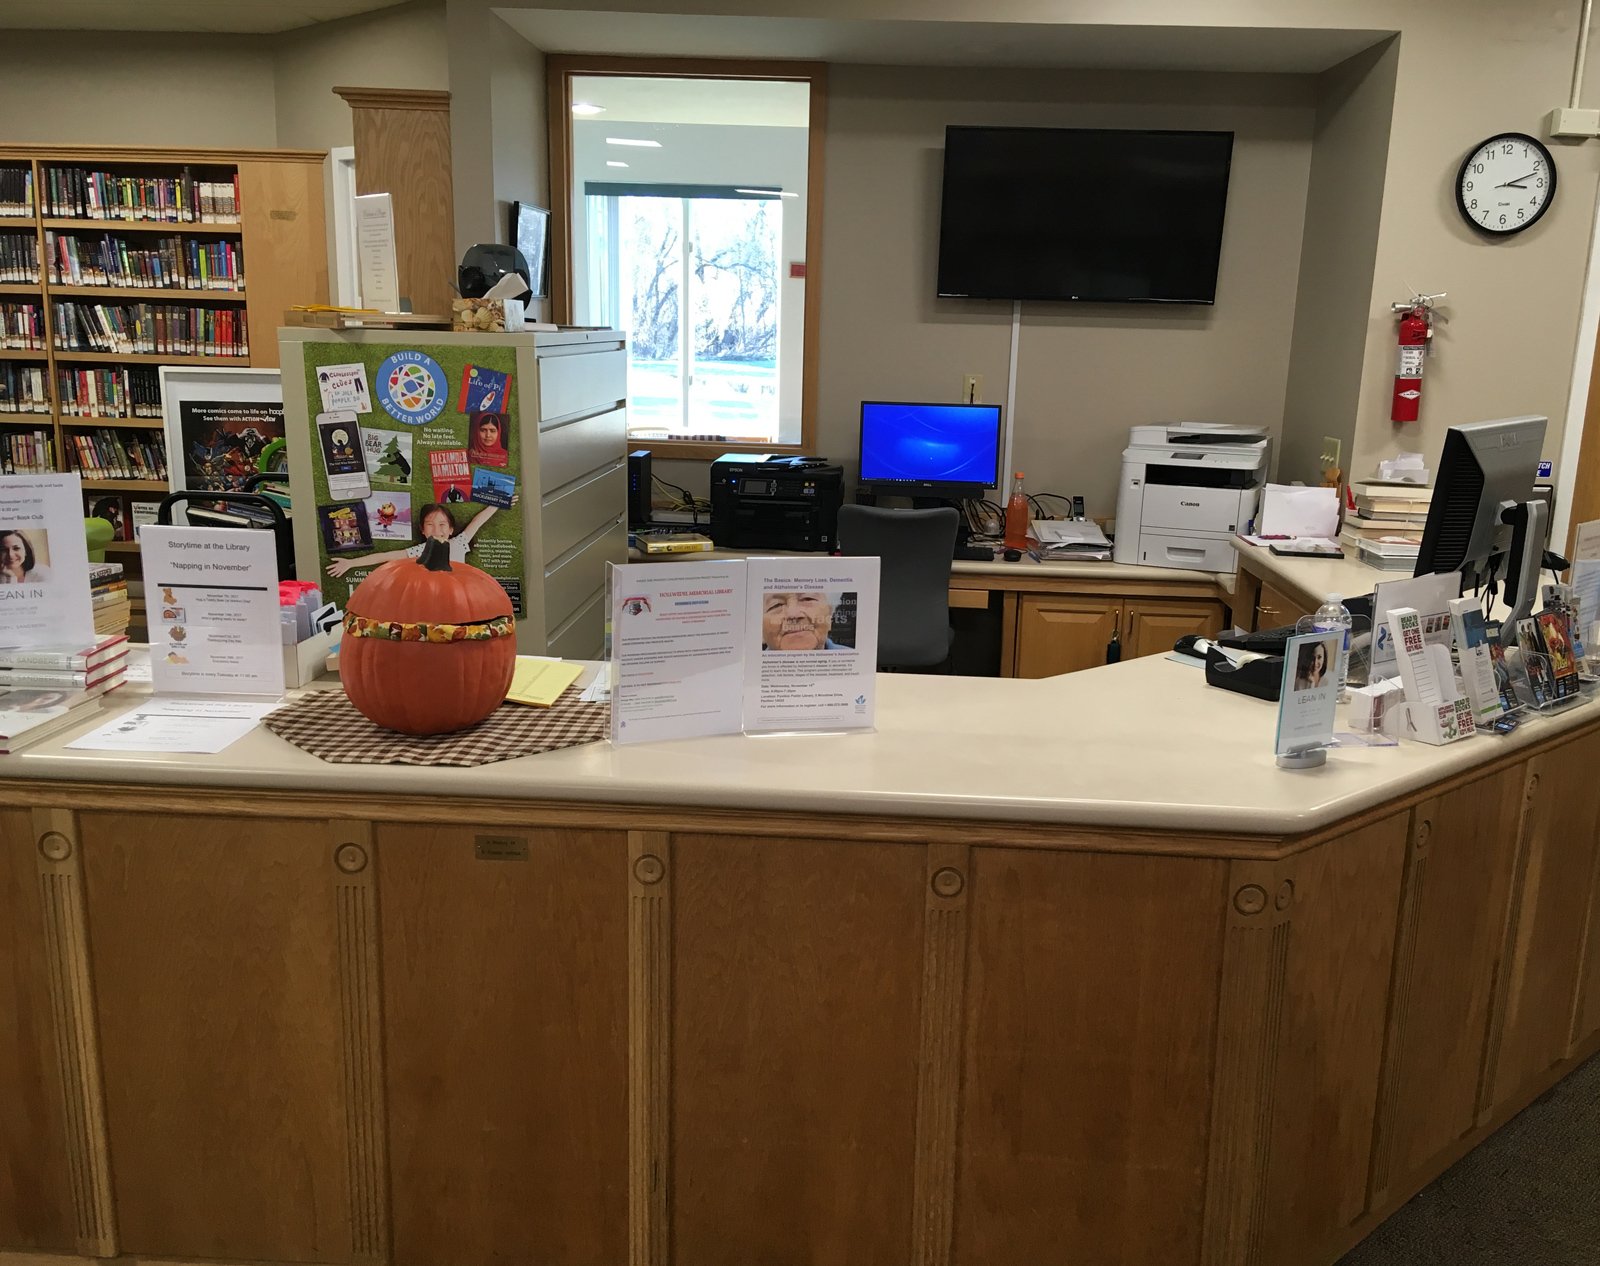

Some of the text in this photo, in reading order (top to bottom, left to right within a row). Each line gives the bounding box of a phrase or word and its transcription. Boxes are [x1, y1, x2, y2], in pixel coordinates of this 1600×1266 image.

[1502, 144, 1513, 154] 12
[1523, 148, 1528, 158] 1
[1486, 150, 1495, 160] 11
[1472, 164, 1484, 174] 10
[1533, 161, 1540, 171] 2
[1466, 181, 1473, 191] 9
[1536, 178, 1543, 188] 3
[1470, 199, 1478, 209] 8
[1530, 196, 1536, 206] 4
[1483, 210, 1489, 220] 7
[1517, 209, 1524, 218] 5
[1500, 214, 1506, 224] 6
[391, 353, 421, 363] BUILD
[468, 378, 483, 386] Life
[382, 398, 444, 423] BETTER WORLD
[431, 452, 468, 464] ALEXANDER
[432, 463, 469, 477] HAMILTON
[168, 541, 202, 550] Storytime
[226, 543, 250, 552] Library
[170, 562, 202, 571] "Napping
[30, 589, 43, 598] IN
[1402, 621, 1418, 629] BOOKS
[1404, 635, 1422, 646] FREE
[1455, 703, 1470, 713] BOOKS
[1458, 717, 1473, 729] FREE
